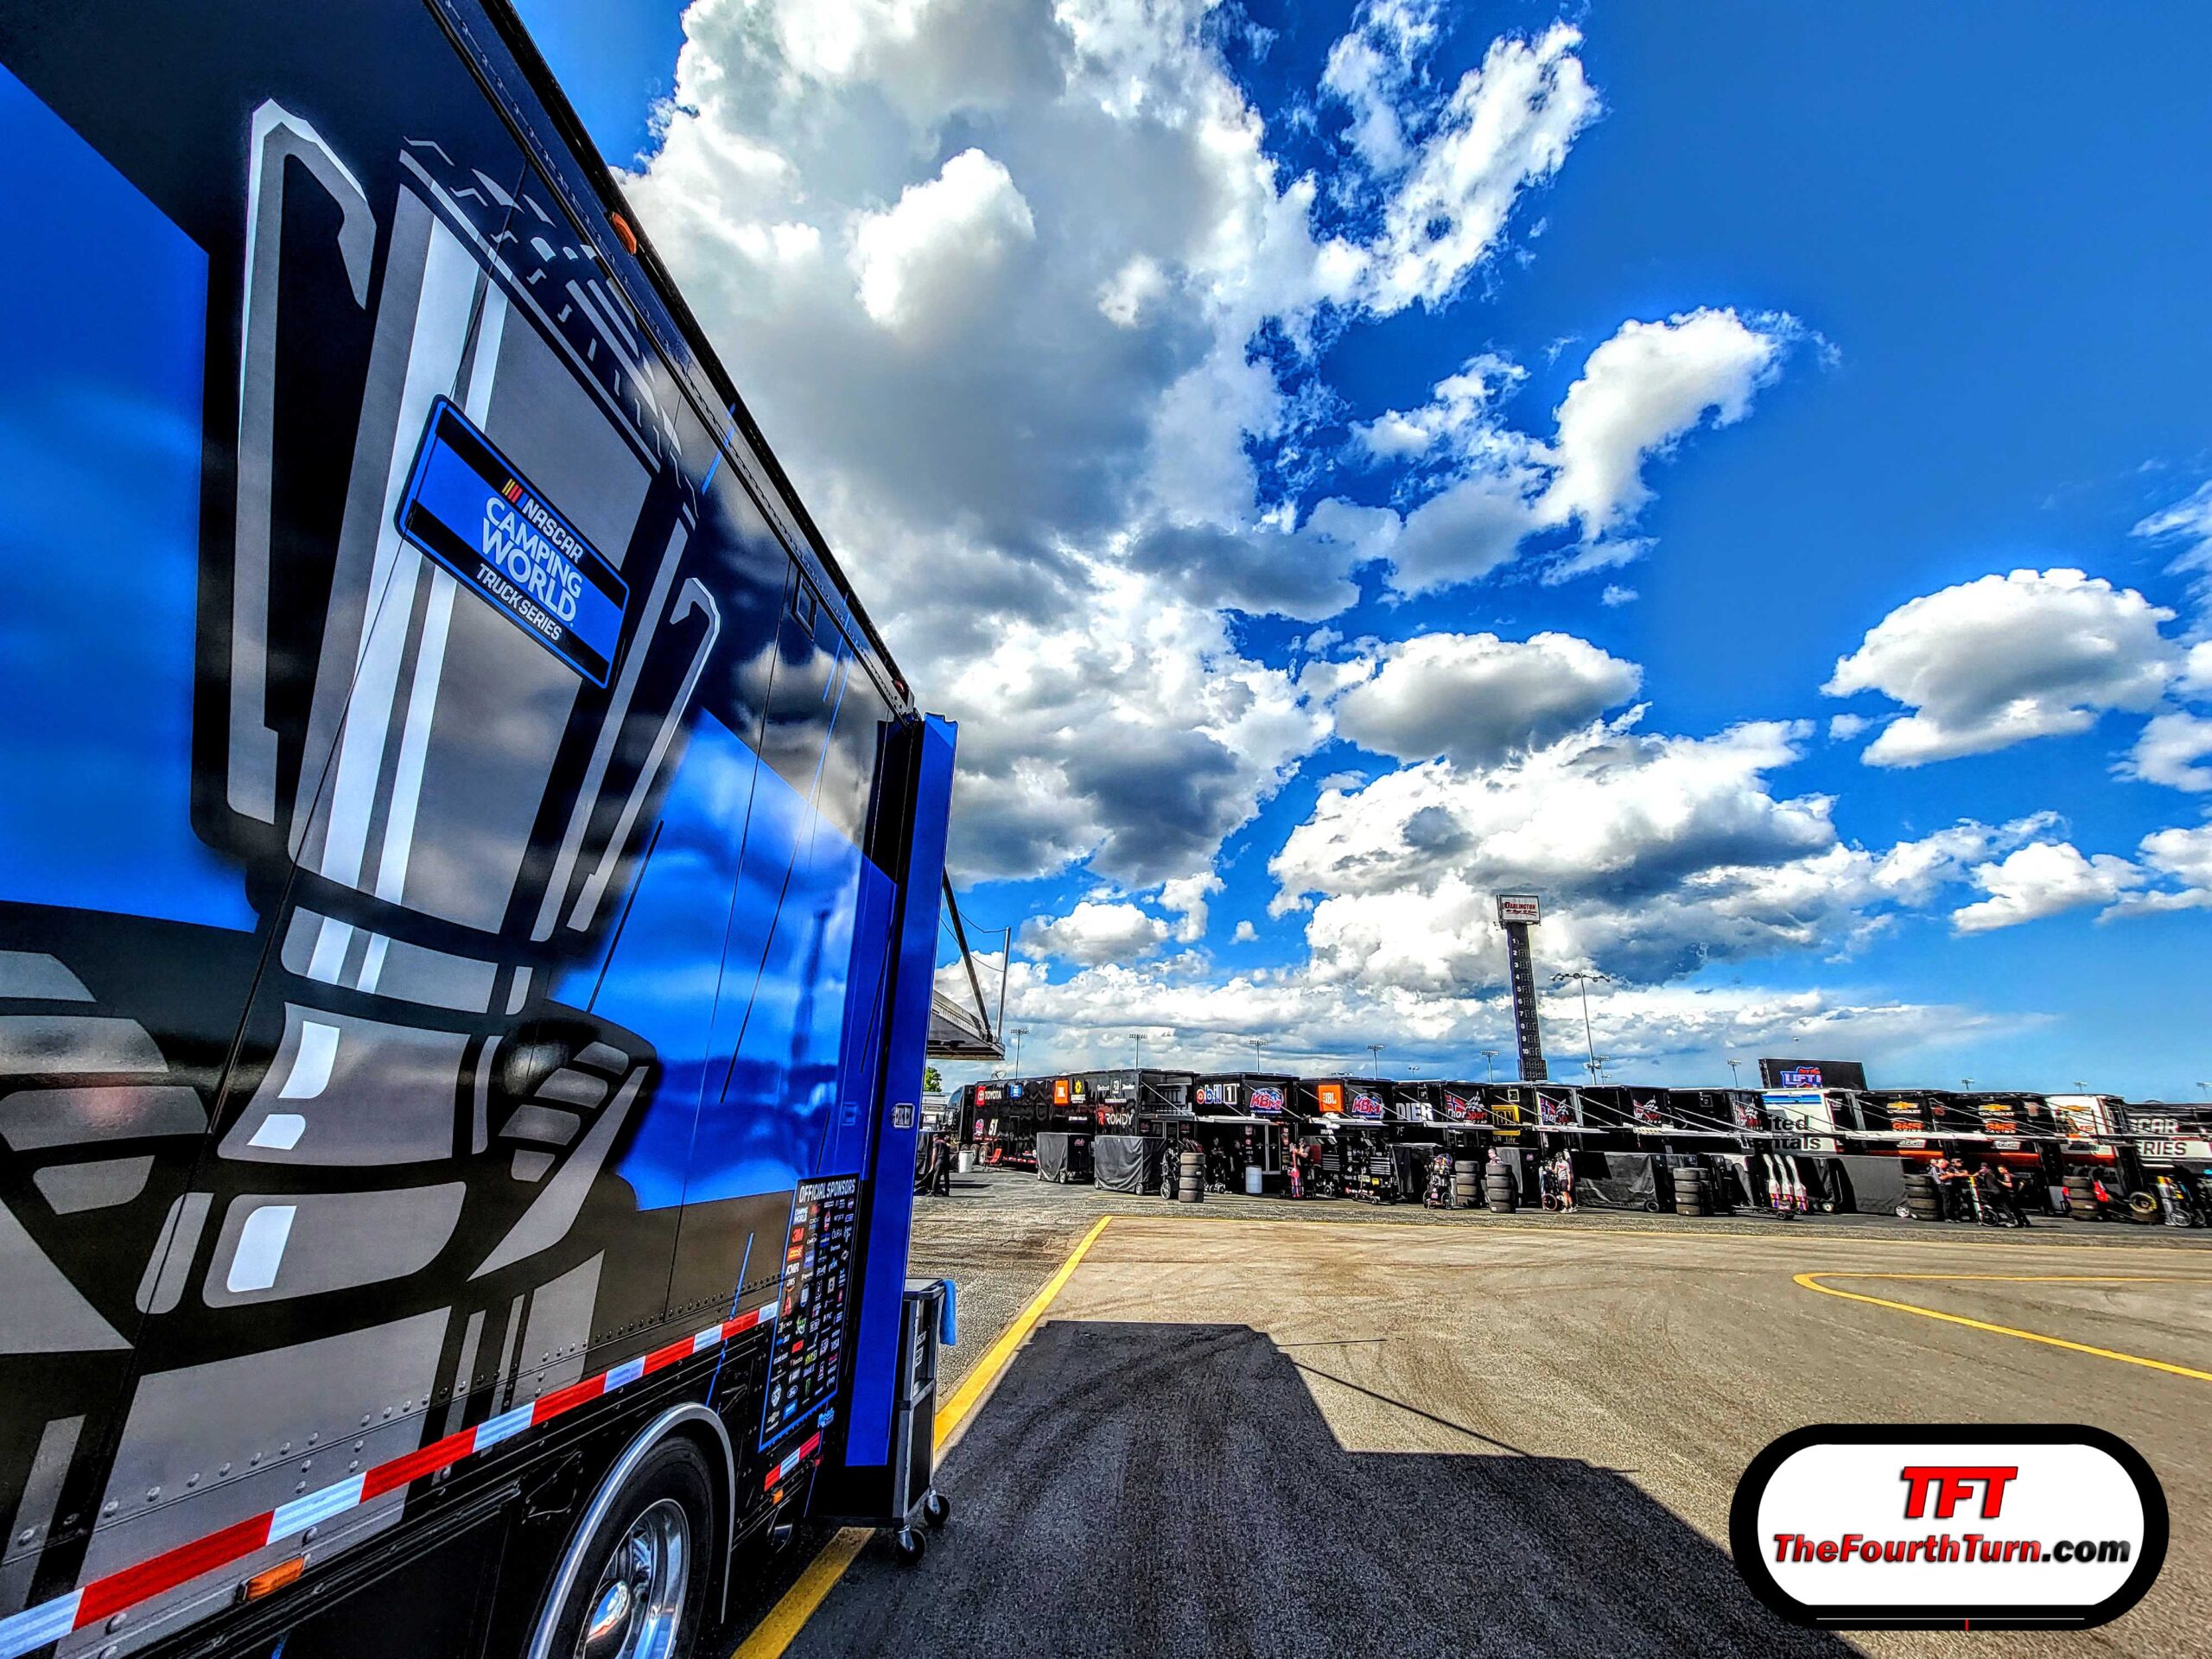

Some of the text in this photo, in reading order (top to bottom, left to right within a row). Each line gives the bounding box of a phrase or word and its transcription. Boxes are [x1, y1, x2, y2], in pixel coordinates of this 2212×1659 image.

[522, 499, 584, 563] NASCAR
[486, 497, 583, 597] CAMPING
[482, 517, 576, 627] WORLD
[476, 563, 563, 641] TRUCK SERIES
[985, 1090, 1001, 1100] TOYOTA
[1196, 1084, 1223, 1104] obil
[1323, 1092, 1337, 1104] JBL
[1351, 1096, 1381, 1115] KBM
[988, 1118, 999, 1135] 51
[1105, 1113, 1134, 1126] ROWDY
[798, 1179, 856, 1204] OFFICIAL SPONSORS
[791, 1227, 805, 1243] 3M
